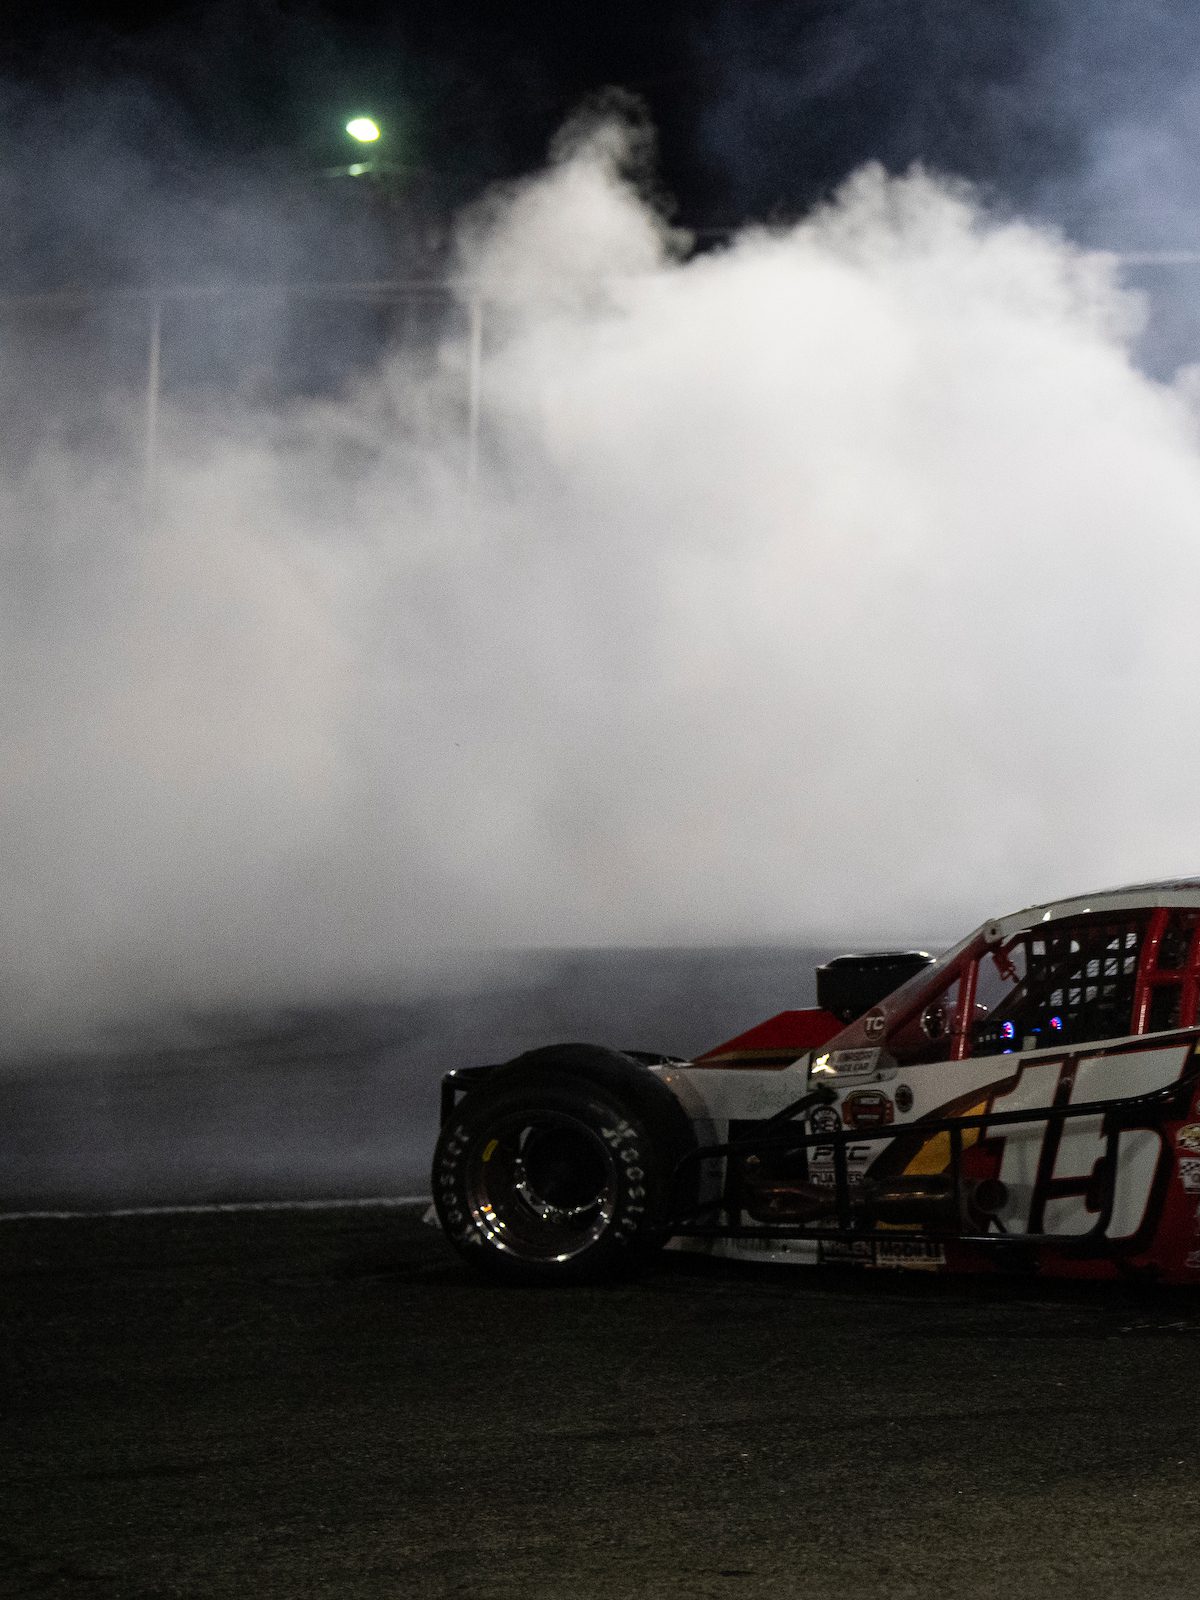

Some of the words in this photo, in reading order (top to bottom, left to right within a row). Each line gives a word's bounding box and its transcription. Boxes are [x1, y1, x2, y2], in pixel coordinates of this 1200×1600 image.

[866, 1016, 885, 1030] TC
[984, 1044, 1192, 1240] 15
[813, 1146, 871, 1161] PC
